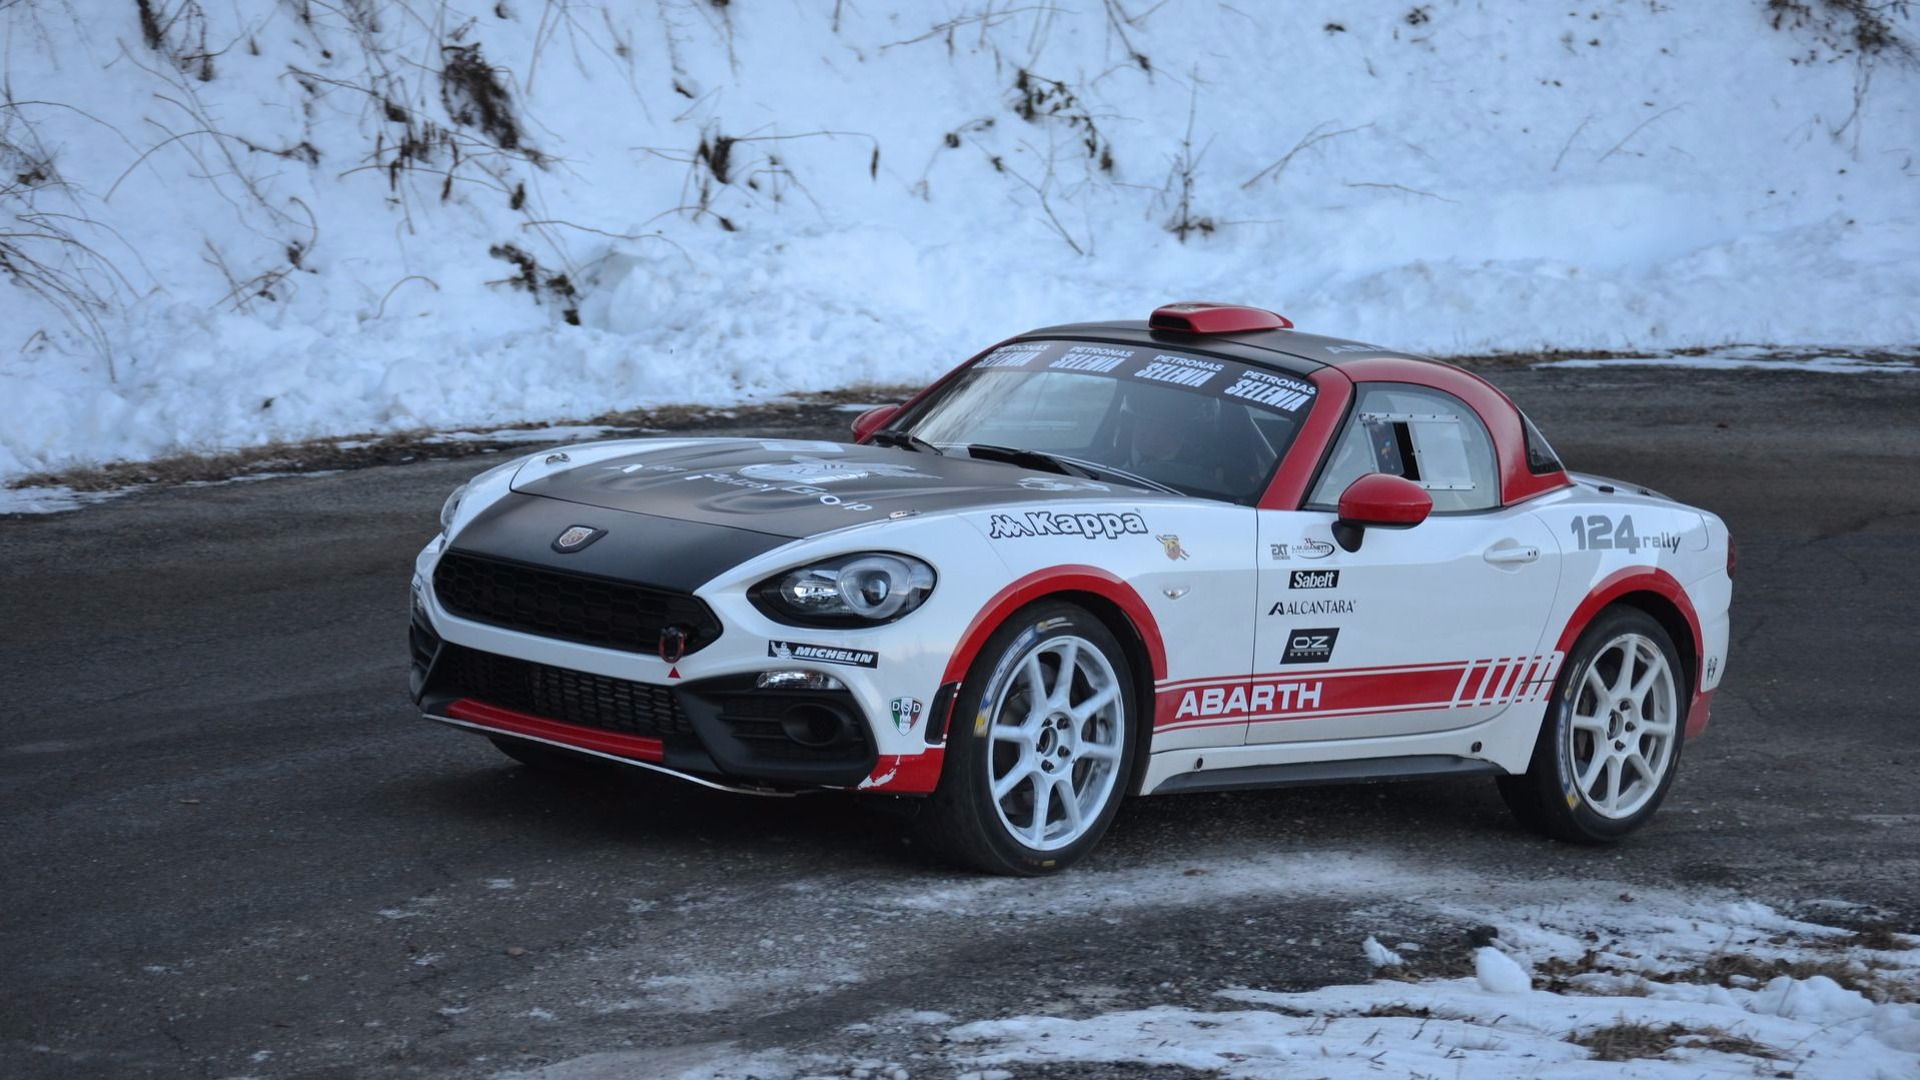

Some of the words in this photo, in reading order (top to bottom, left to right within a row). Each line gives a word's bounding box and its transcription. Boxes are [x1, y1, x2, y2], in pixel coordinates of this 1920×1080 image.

[1068, 346, 1134, 358] PETRONAS
[1153, 354, 1224, 372] PETRONAS
[1134, 362, 1217, 388] SELENIA
[1242, 370, 1317, 396] PETRONAS
[1224, 378, 1311, 412] SELENIA
[1025, 511, 1148, 539] Kappa
[1571, 514, 1640, 554] 124
[1642, 532, 1681, 554] rally
[1294, 571, 1335, 588] Sabelt
[1286, 600, 1354, 615] ALCANTARA
[795, 645, 874, 664] MICHELIN
[1175, 682, 1323, 719] ABARTH
